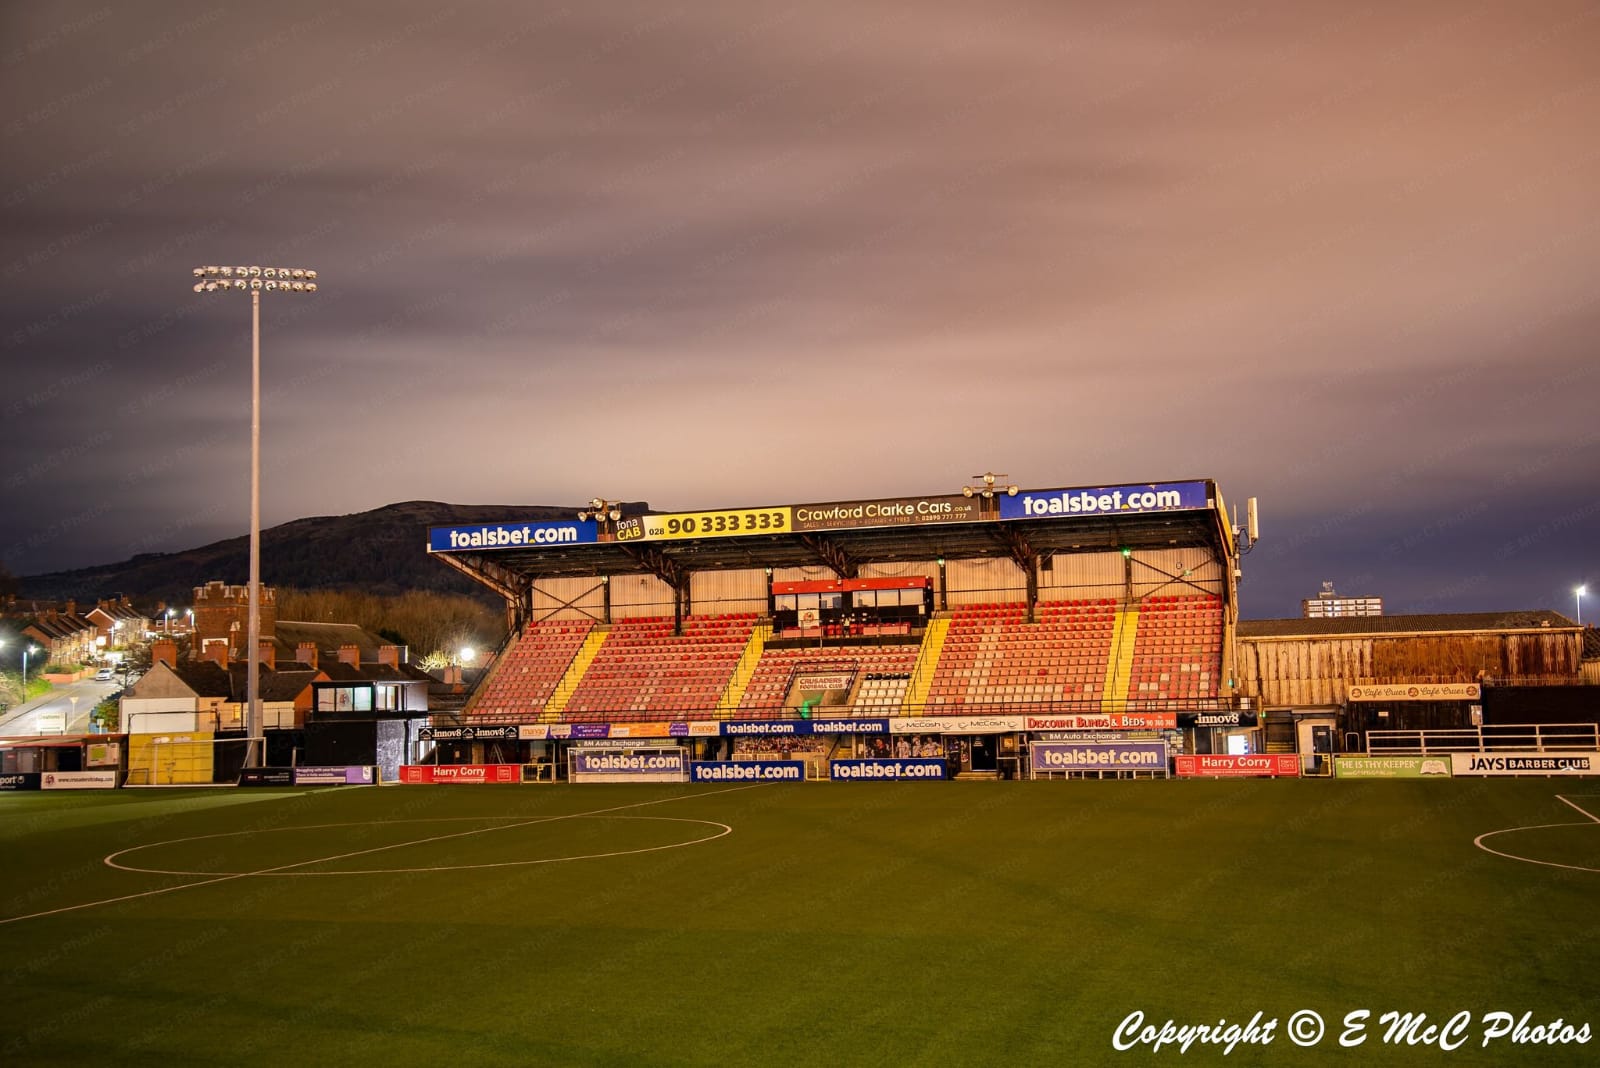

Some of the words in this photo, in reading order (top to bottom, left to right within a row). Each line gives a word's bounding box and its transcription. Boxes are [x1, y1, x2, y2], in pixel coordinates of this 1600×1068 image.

[1023, 489, 1181, 515] toalsbet.com
[797, 505, 863, 521] Crawford
[865, 503, 915, 517] Clarke
[917, 501, 952, 514] Cars
[616, 518, 638, 531] fona
[649, 528, 665, 536] 028
[667, 518, 696, 535] 90
[701, 515, 740, 533] 333
[745, 512, 785, 530] 333
[450, 526, 577, 548] toalsbet.com
[616, 527, 642, 541] CAB
[692, 725, 716, 733] mango
[726, 723, 794, 734] toalsbet.com
[813, 722, 882, 732] toalsbet.com
[1027, 717, 1073, 729] DISCOUNT
[1076, 716, 1110, 728] BLINDS
[1111, 718, 1118, 727] &
[1121, 716, 1145, 726] BEDS
[1083, 732, 1121, 740] Exchange
[612, 739, 645, 748] Exchange
[585, 754, 680, 769] toalsbet.com
[1044, 749, 1158, 765] toalsbet.com
[1202, 757, 1233, 768] Harry
[1238, 756, 1271, 768] Corry
[833, 763, 942, 778] toalsbet.com
[1355, 760, 1363, 768] IS
[1364, 760, 1381, 768] THY
[1509, 759, 1556, 769] BARBER
[1557, 759, 1590, 769] CLUB
[433, 767, 458, 777] Harry
[461, 767, 486, 777] Corry
[696, 764, 799, 779] toalsbet.com
